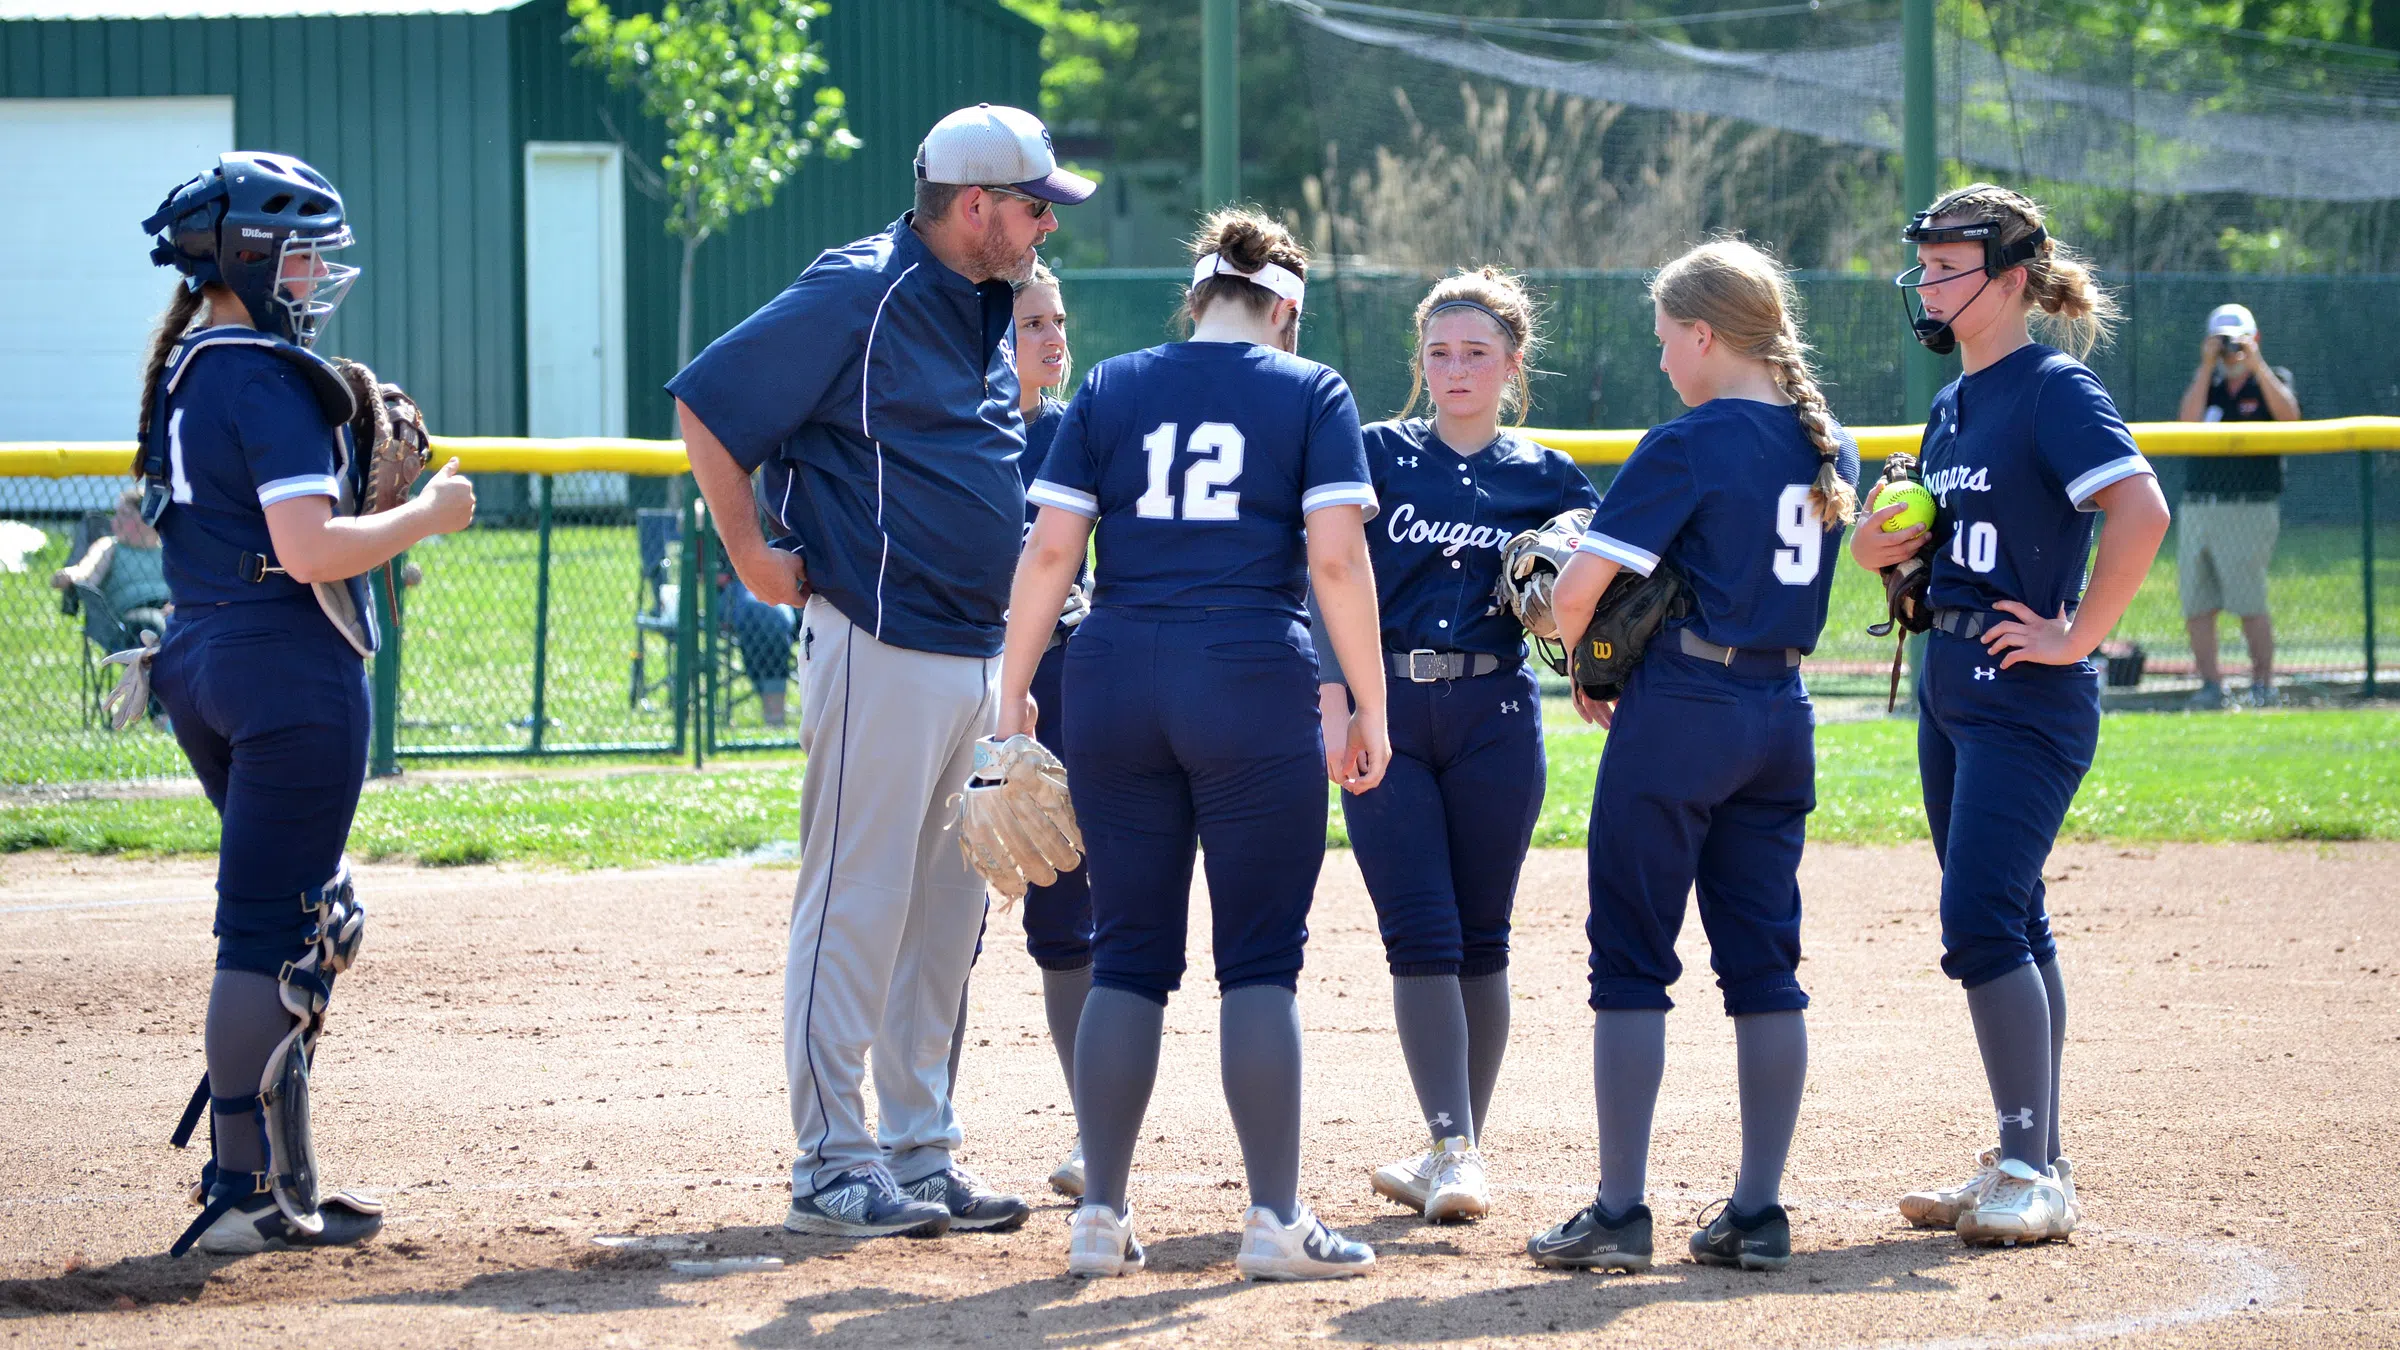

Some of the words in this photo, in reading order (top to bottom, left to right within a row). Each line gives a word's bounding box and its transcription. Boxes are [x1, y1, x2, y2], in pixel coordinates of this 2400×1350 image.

[241, 228, 273, 239] Wilson
[1136, 421, 1245, 520] 12
[1388, 503, 1513, 557] Cougar
[1772, 484, 1823, 585] 9
[1951, 520, 1998, 573] 10
[1592, 641, 1612, 659] W
